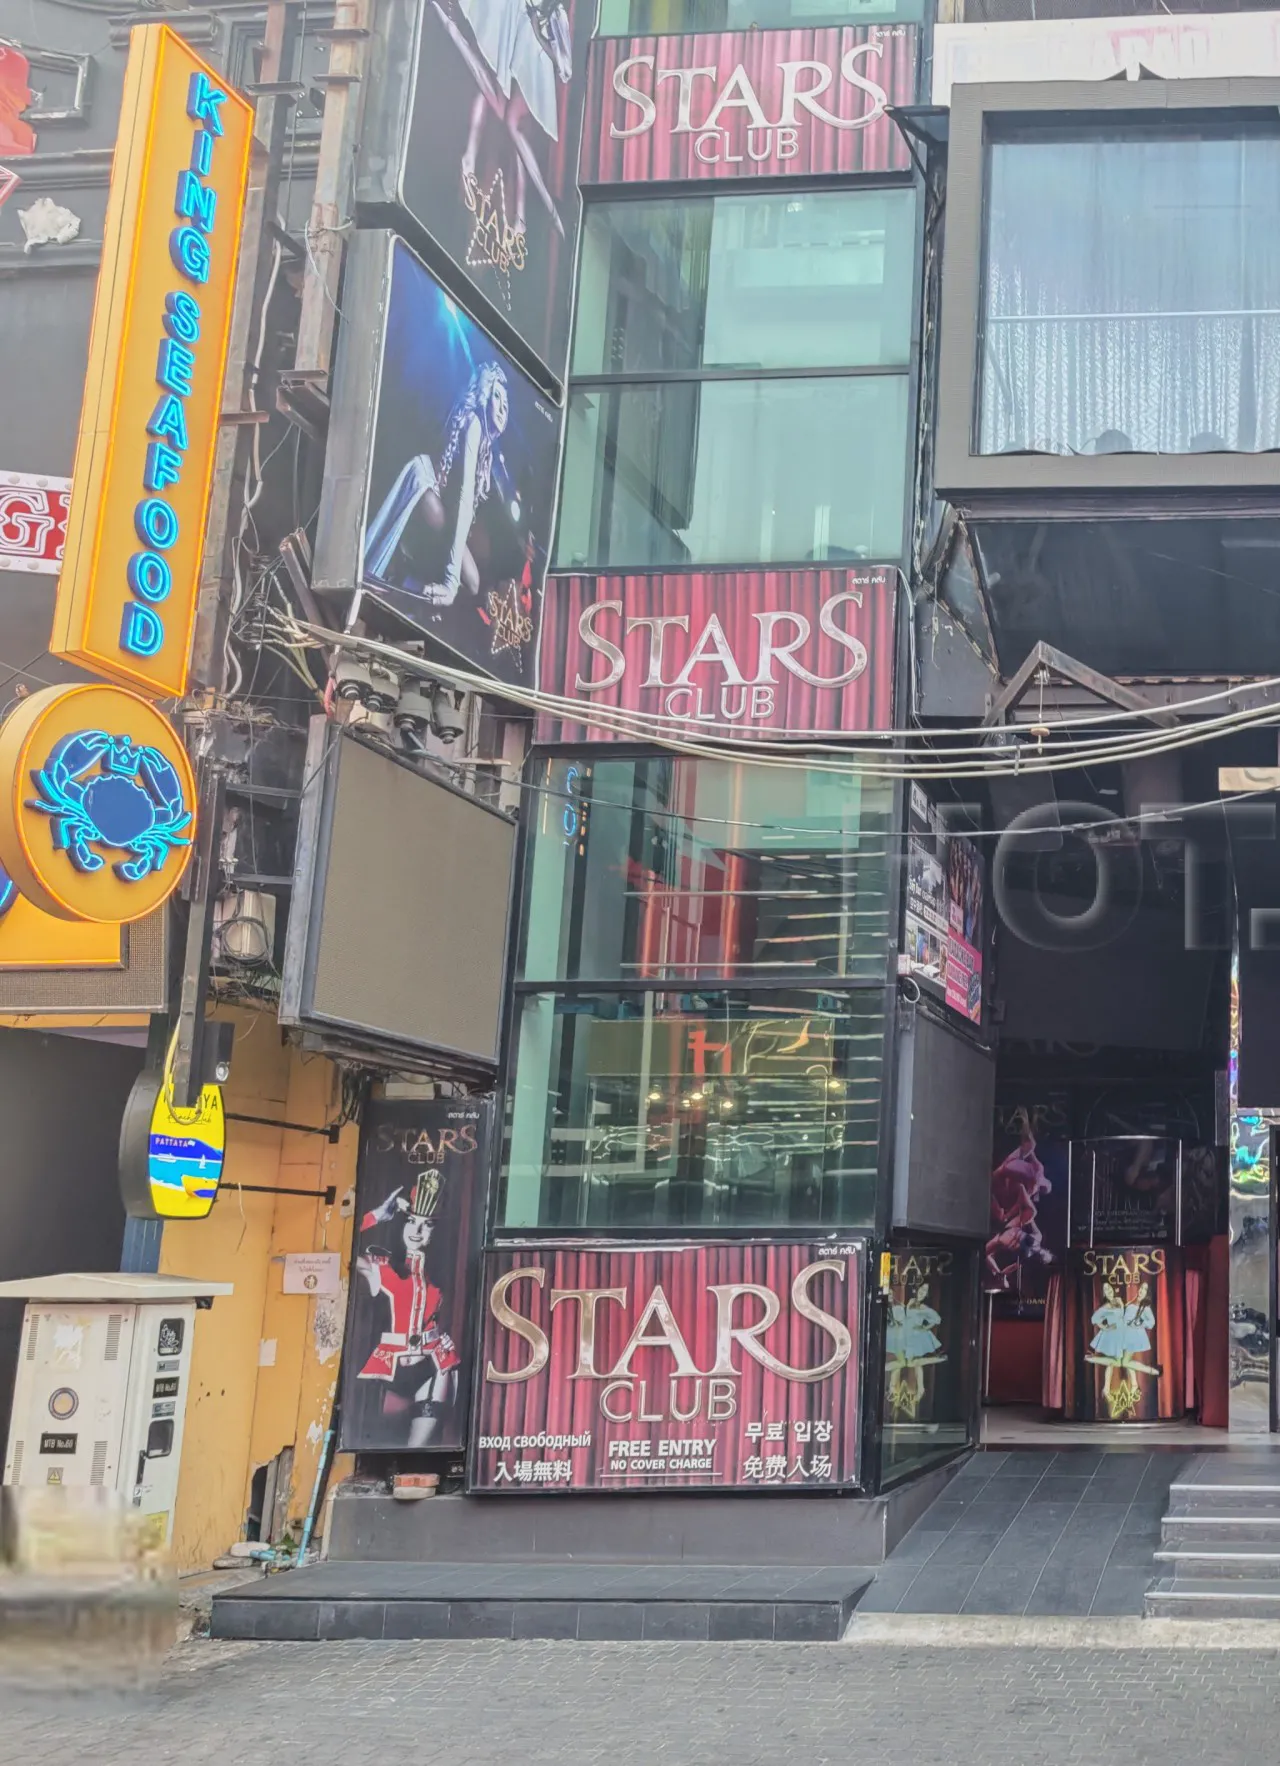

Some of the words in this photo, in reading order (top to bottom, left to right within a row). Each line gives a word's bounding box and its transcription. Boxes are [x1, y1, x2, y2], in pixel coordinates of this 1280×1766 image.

[609, 42, 888, 140] STARS
[694, 127, 800, 164] CLUB
[168, 71, 228, 284] KING
[462, 171, 526, 271] STARS
[475, 225, 510, 273] CLUB
[118, 289, 203, 658] SEAFOOD
[489, 591, 533, 643] STARS
[574, 591, 868, 692] STARS
[664, 686, 776, 721] CLUB
[154, 1137, 189, 1148] PATTAYA
[376, 1124, 478, 1154] STARS
[407, 1151, 446, 1165] CLUB
[1083, 1248, 1166, 1277] STARS
[1108, 1272, 1141, 1286] CLUB
[485, 1259, 852, 1384] STARS
[599, 1377, 738, 1425] CLUB
[43, 1439, 55, 1449] MTB
[744, 1421, 785, 1442] 무료
[794, 1420, 833, 1442] 입장
[608, 1440, 651, 1457] FREE
[658, 1439, 717, 1456] ENTRY
[493, 1459, 573, 1483] 入場無料
[610, 1459, 627, 1471] NO
[630, 1459, 666, 1470] COVER
[669, 1458, 712, 1469] CHARGE
[742, 1454, 833, 1480] 免费入场
